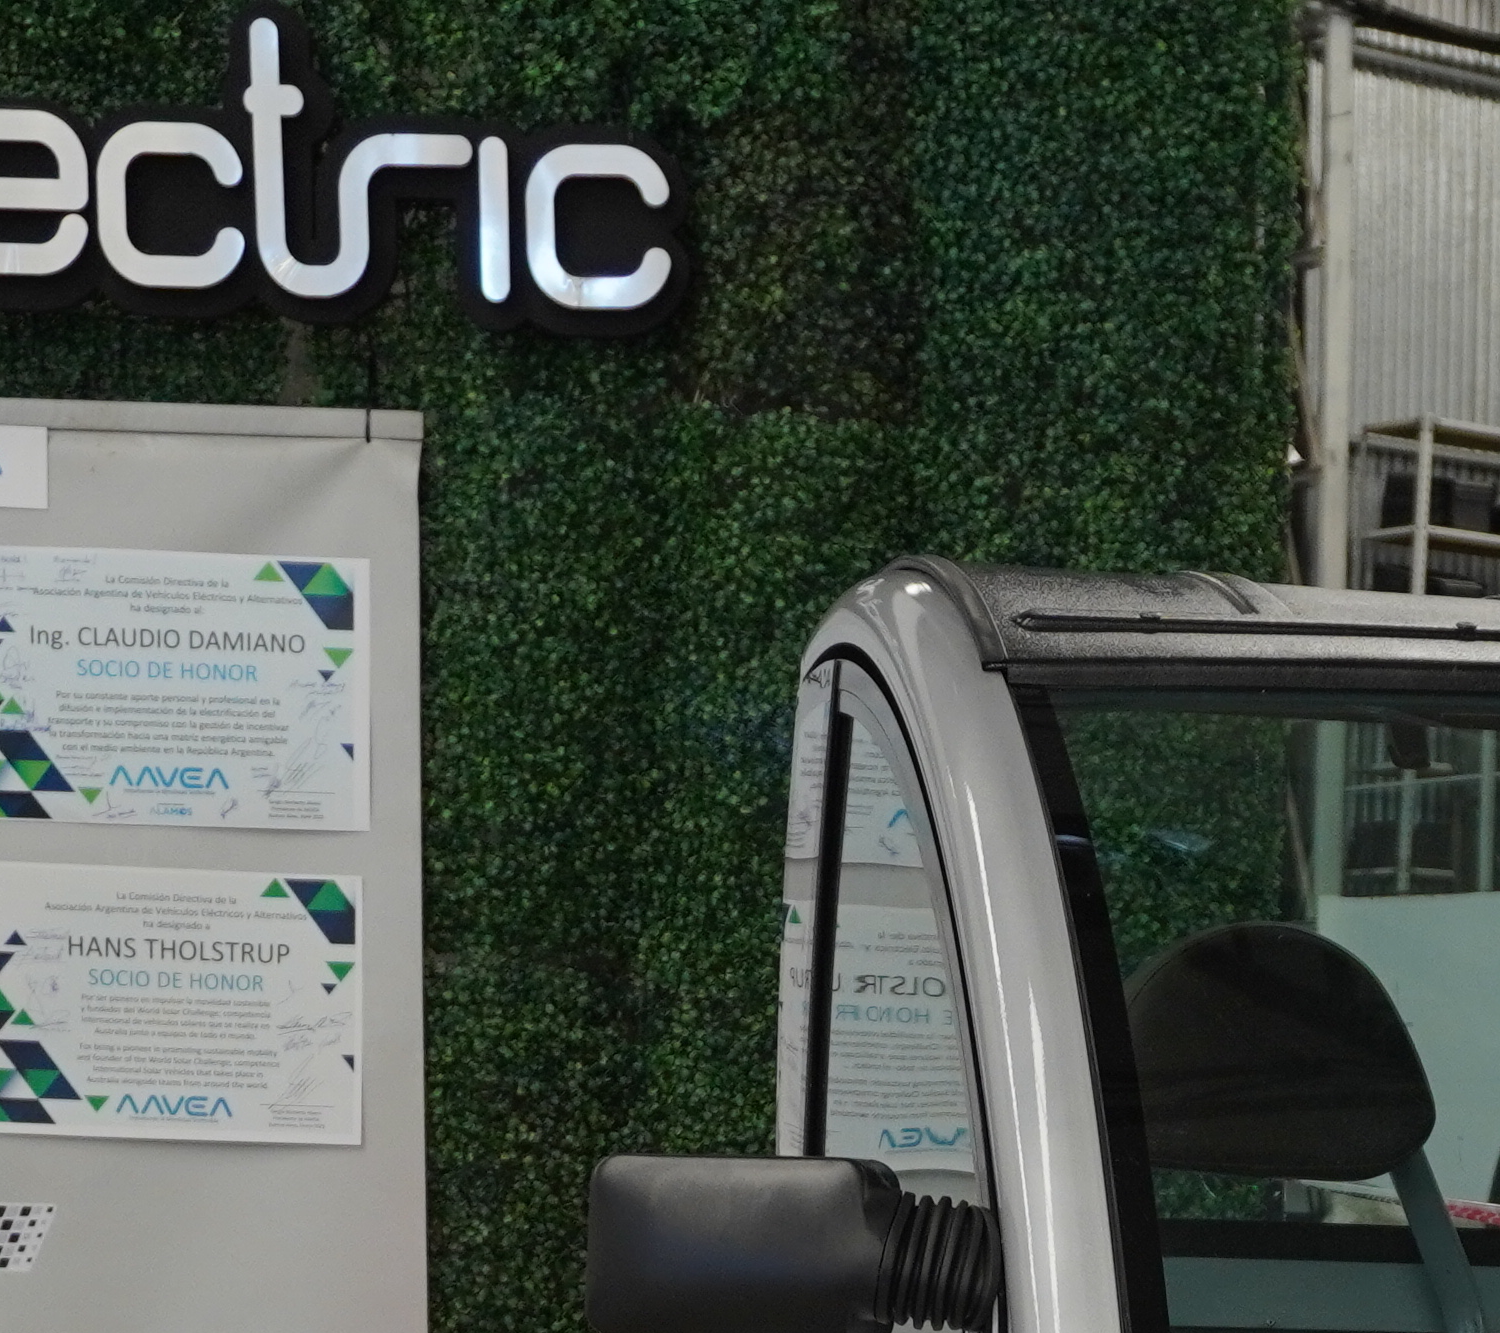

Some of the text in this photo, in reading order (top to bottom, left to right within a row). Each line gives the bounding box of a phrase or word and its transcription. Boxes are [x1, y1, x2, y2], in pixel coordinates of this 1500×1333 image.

[29, 623, 304, 654] Ing. CLAUDIO DAMIANO
[77, 658, 258, 682] SOCIO DE HONOR
[68, 935, 290, 964] HANS THOLSTRUP
[88, 968, 263, 991] SOCIO DE HONOR
